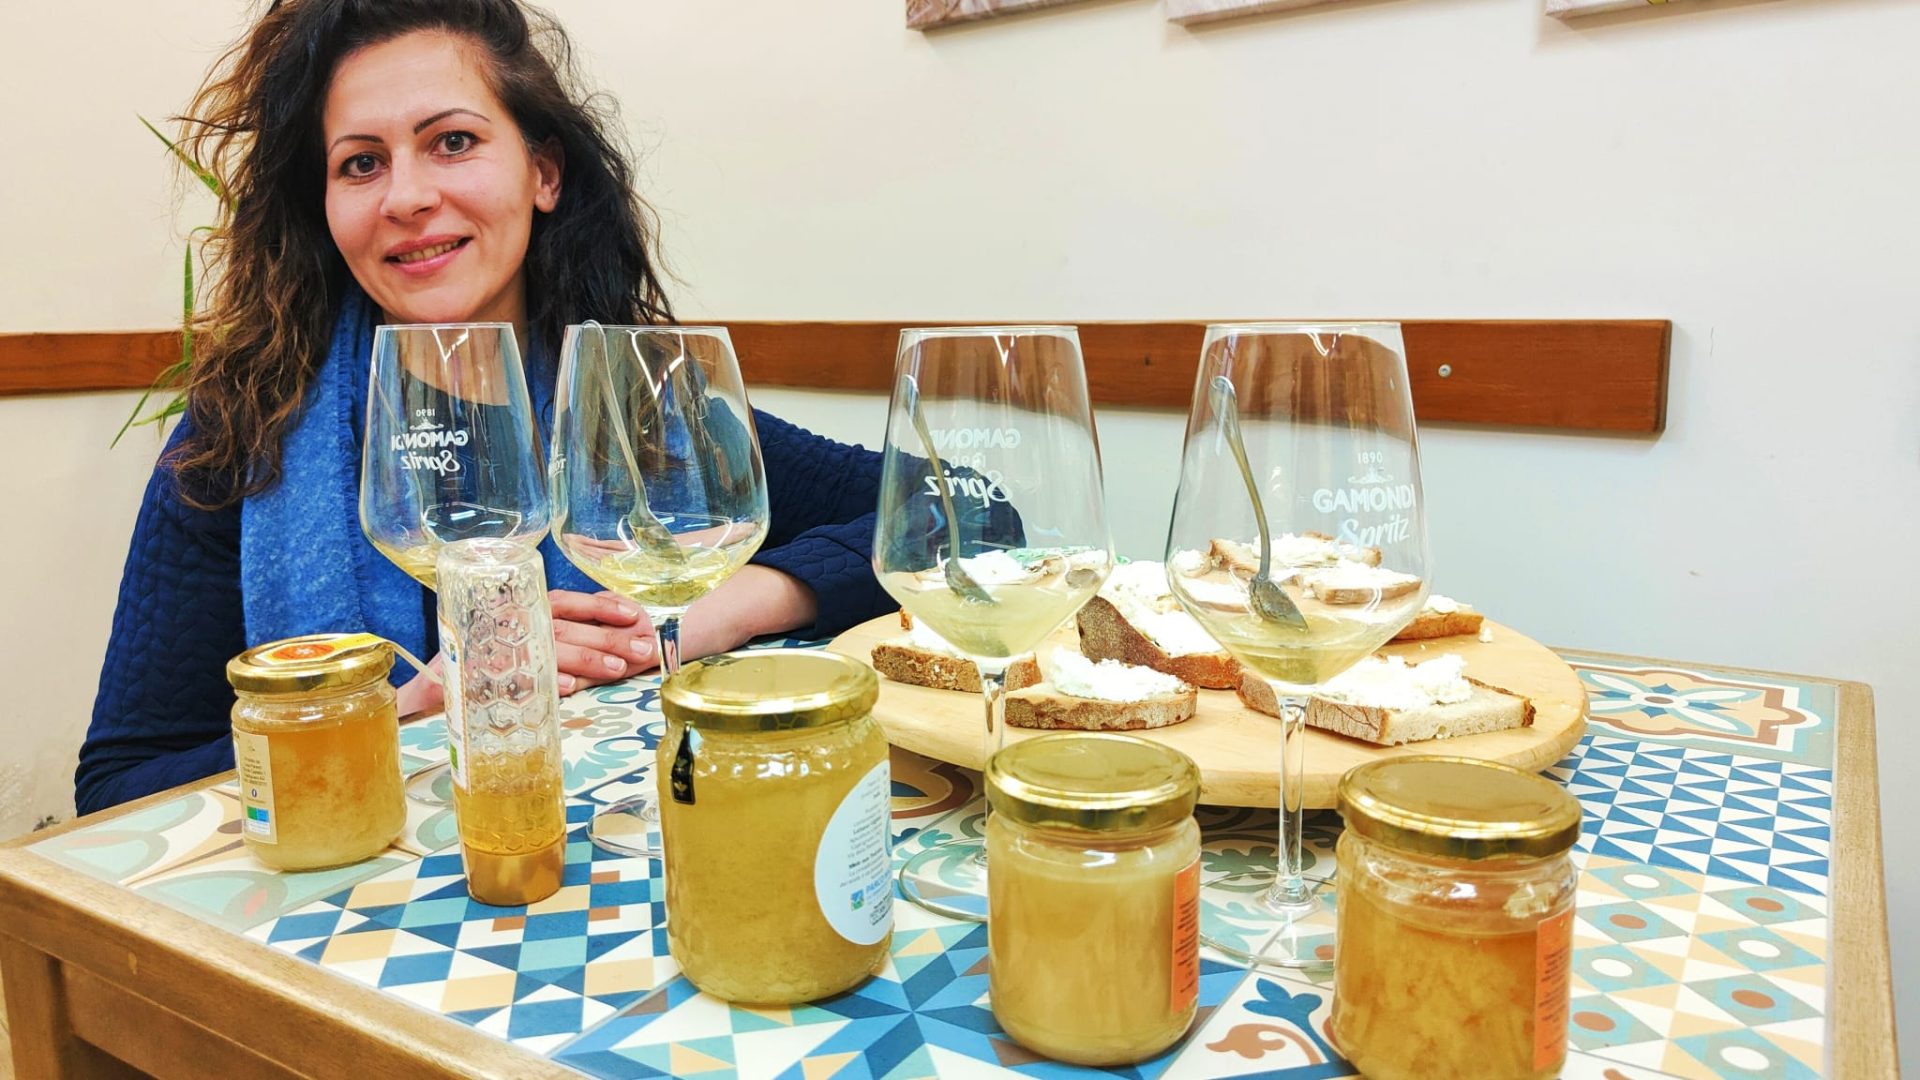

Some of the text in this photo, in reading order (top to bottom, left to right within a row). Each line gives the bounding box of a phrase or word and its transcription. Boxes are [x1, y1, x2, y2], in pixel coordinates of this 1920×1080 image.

[1357, 451, 1383, 464] 1890
[1311, 483, 1417, 513] GAMONDI
[1332, 513, 1411, 554] Spritz
